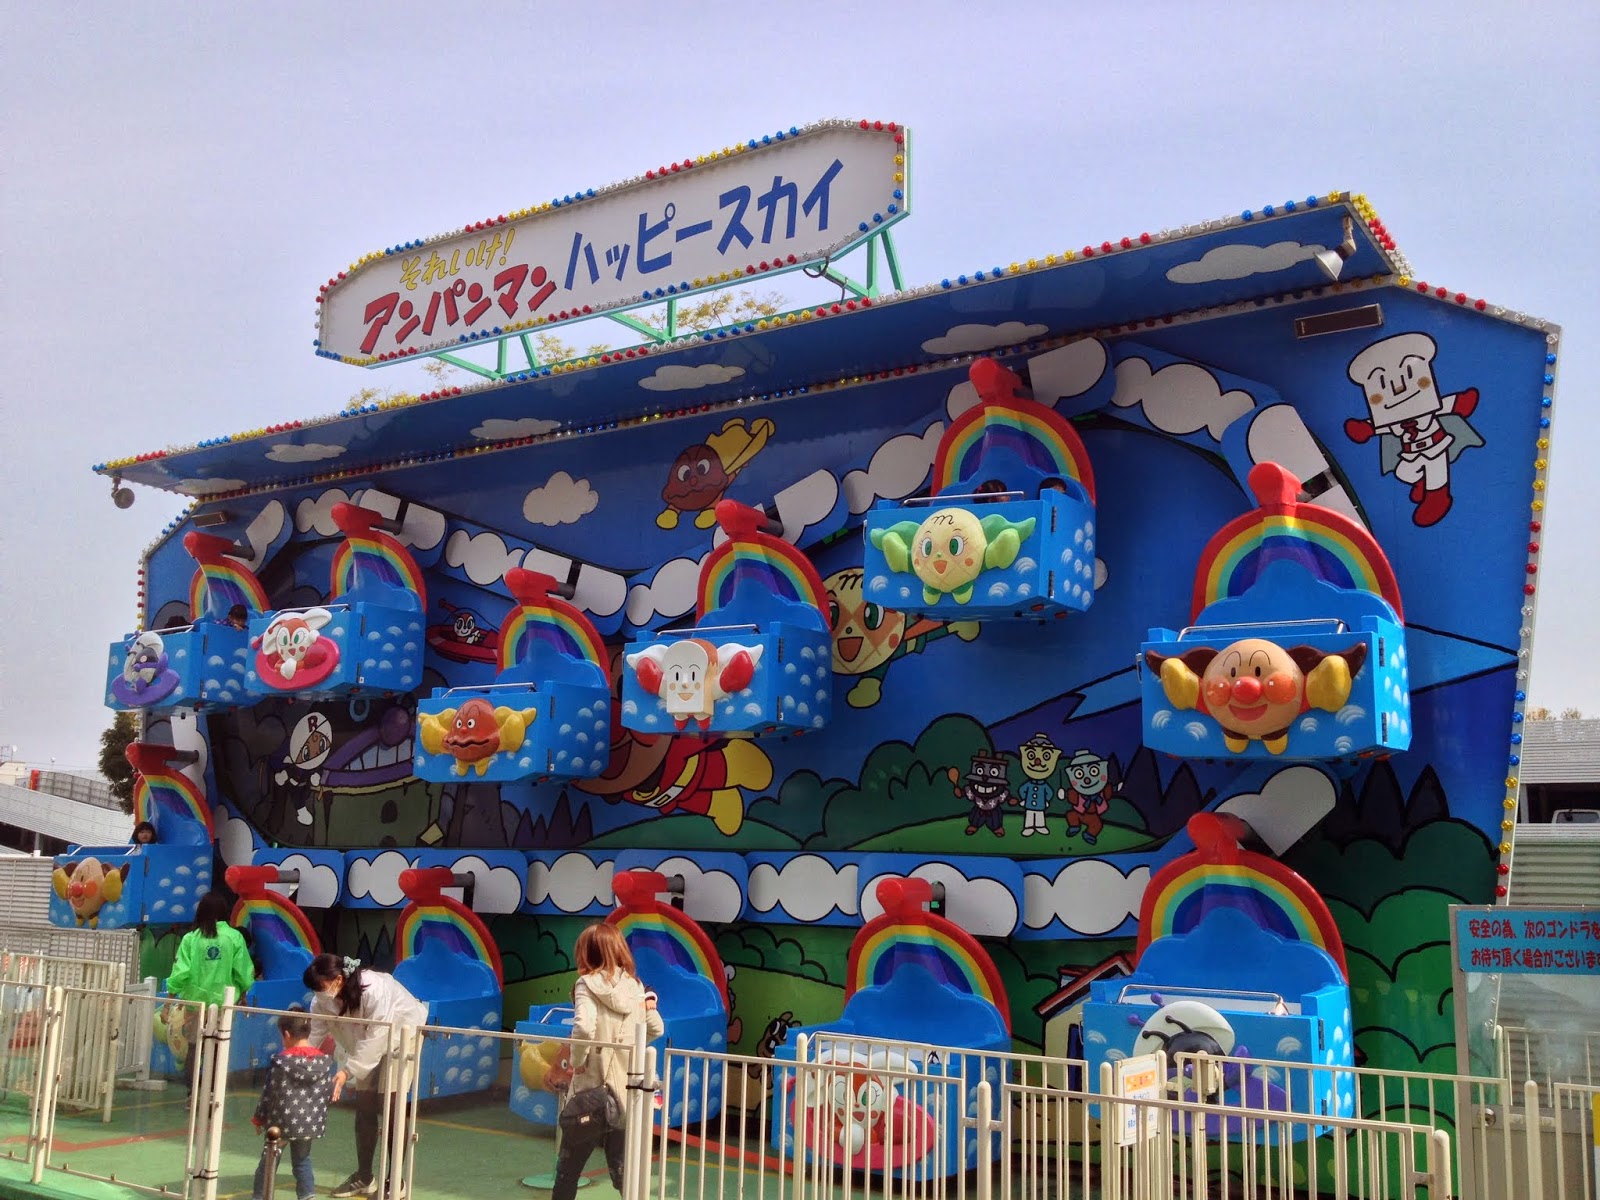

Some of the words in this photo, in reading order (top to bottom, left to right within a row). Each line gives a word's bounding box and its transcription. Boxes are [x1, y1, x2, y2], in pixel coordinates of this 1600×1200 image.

[360, 263, 557, 354] アンパンマン
[564, 158, 844, 290] ハッピースカイ
[308, 715, 318, 733] R
